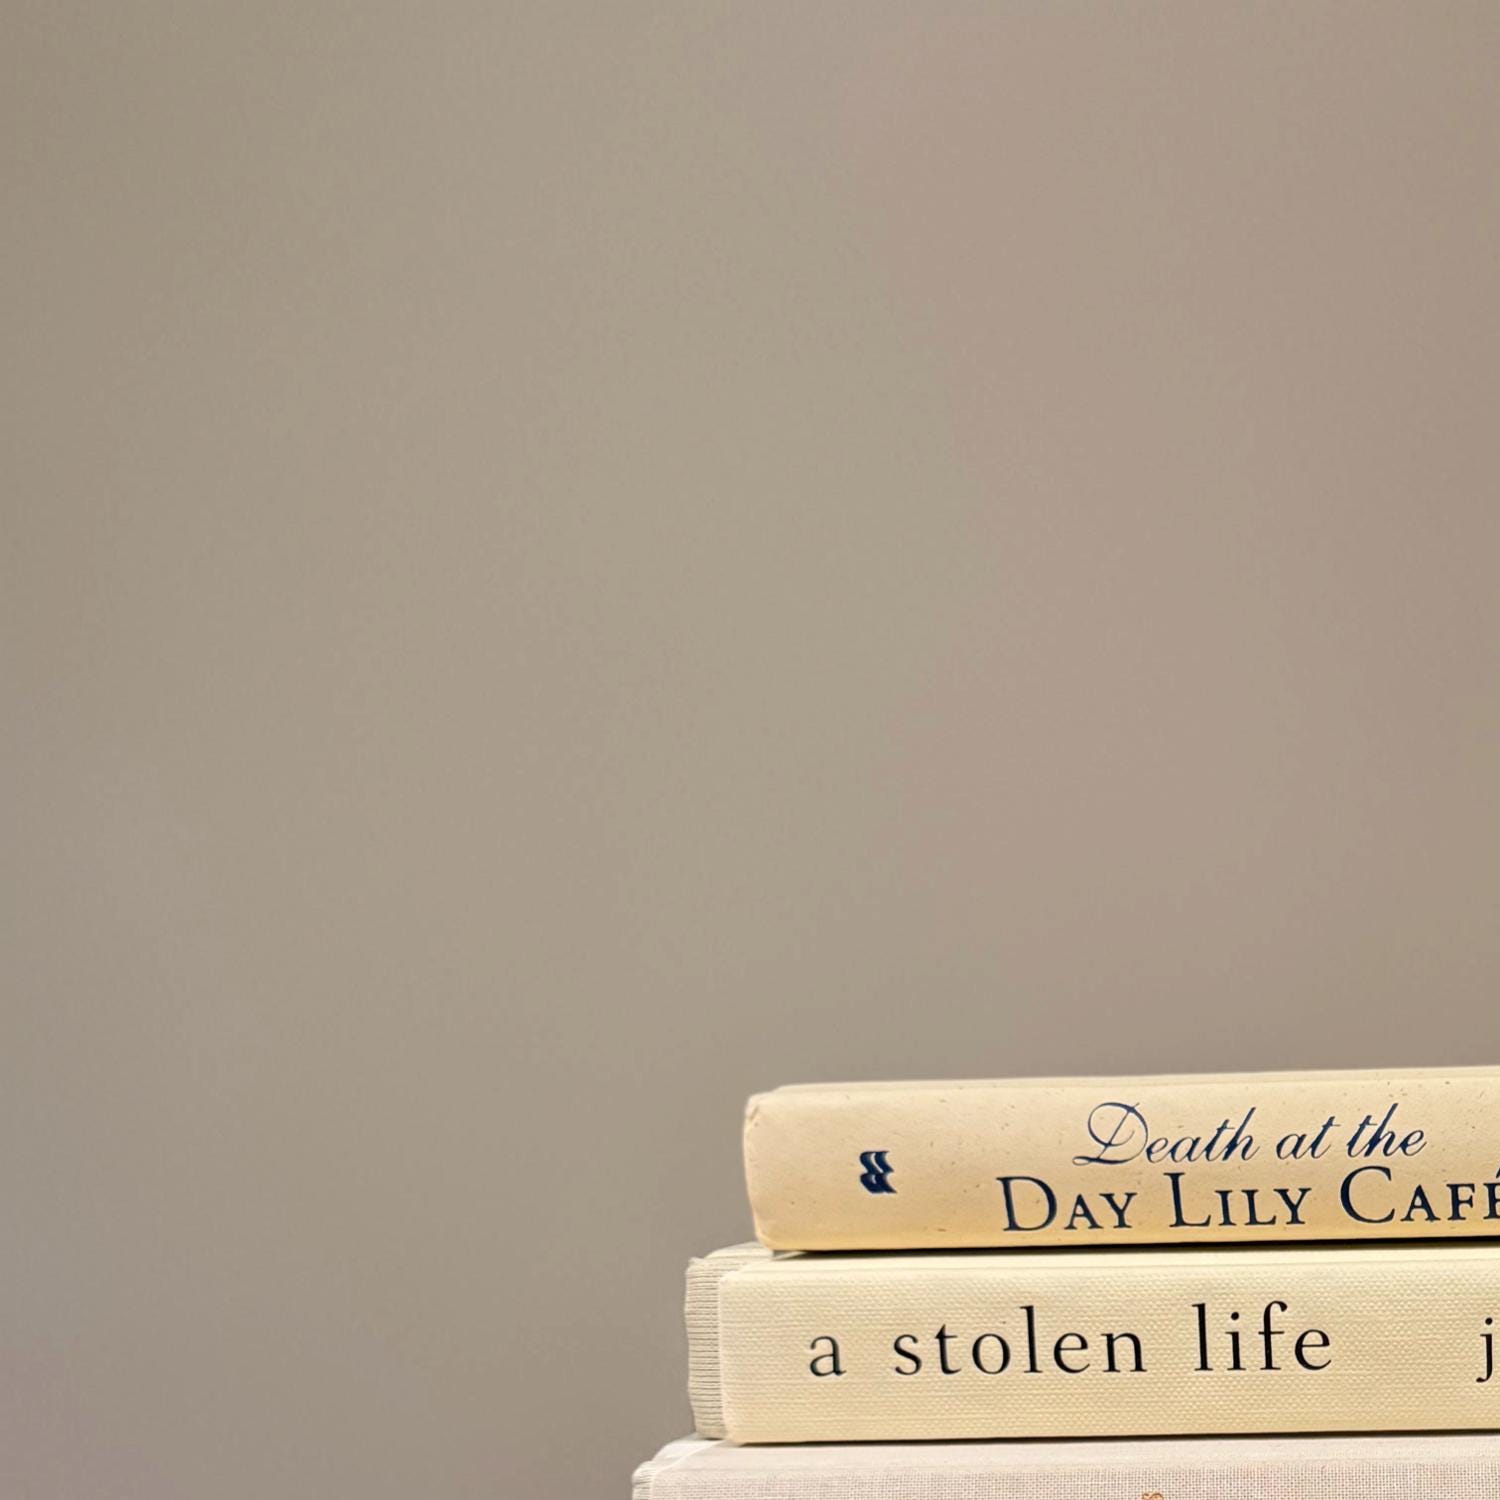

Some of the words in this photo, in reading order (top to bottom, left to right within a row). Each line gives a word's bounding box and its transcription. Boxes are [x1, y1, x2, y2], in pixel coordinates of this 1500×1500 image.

[1074, 1102, 1257, 1166] Death
[1275, 1116, 1335, 1160] at
[1346, 1102, 1426, 1158] the
[996, 1175, 1137, 1232] DAY
[1164, 1171, 1312, 1228] LILY
[809, 1335, 846, 1377] a
[893, 1304, 1147, 1376] stolen
[1191, 1300, 1332, 1372] life
